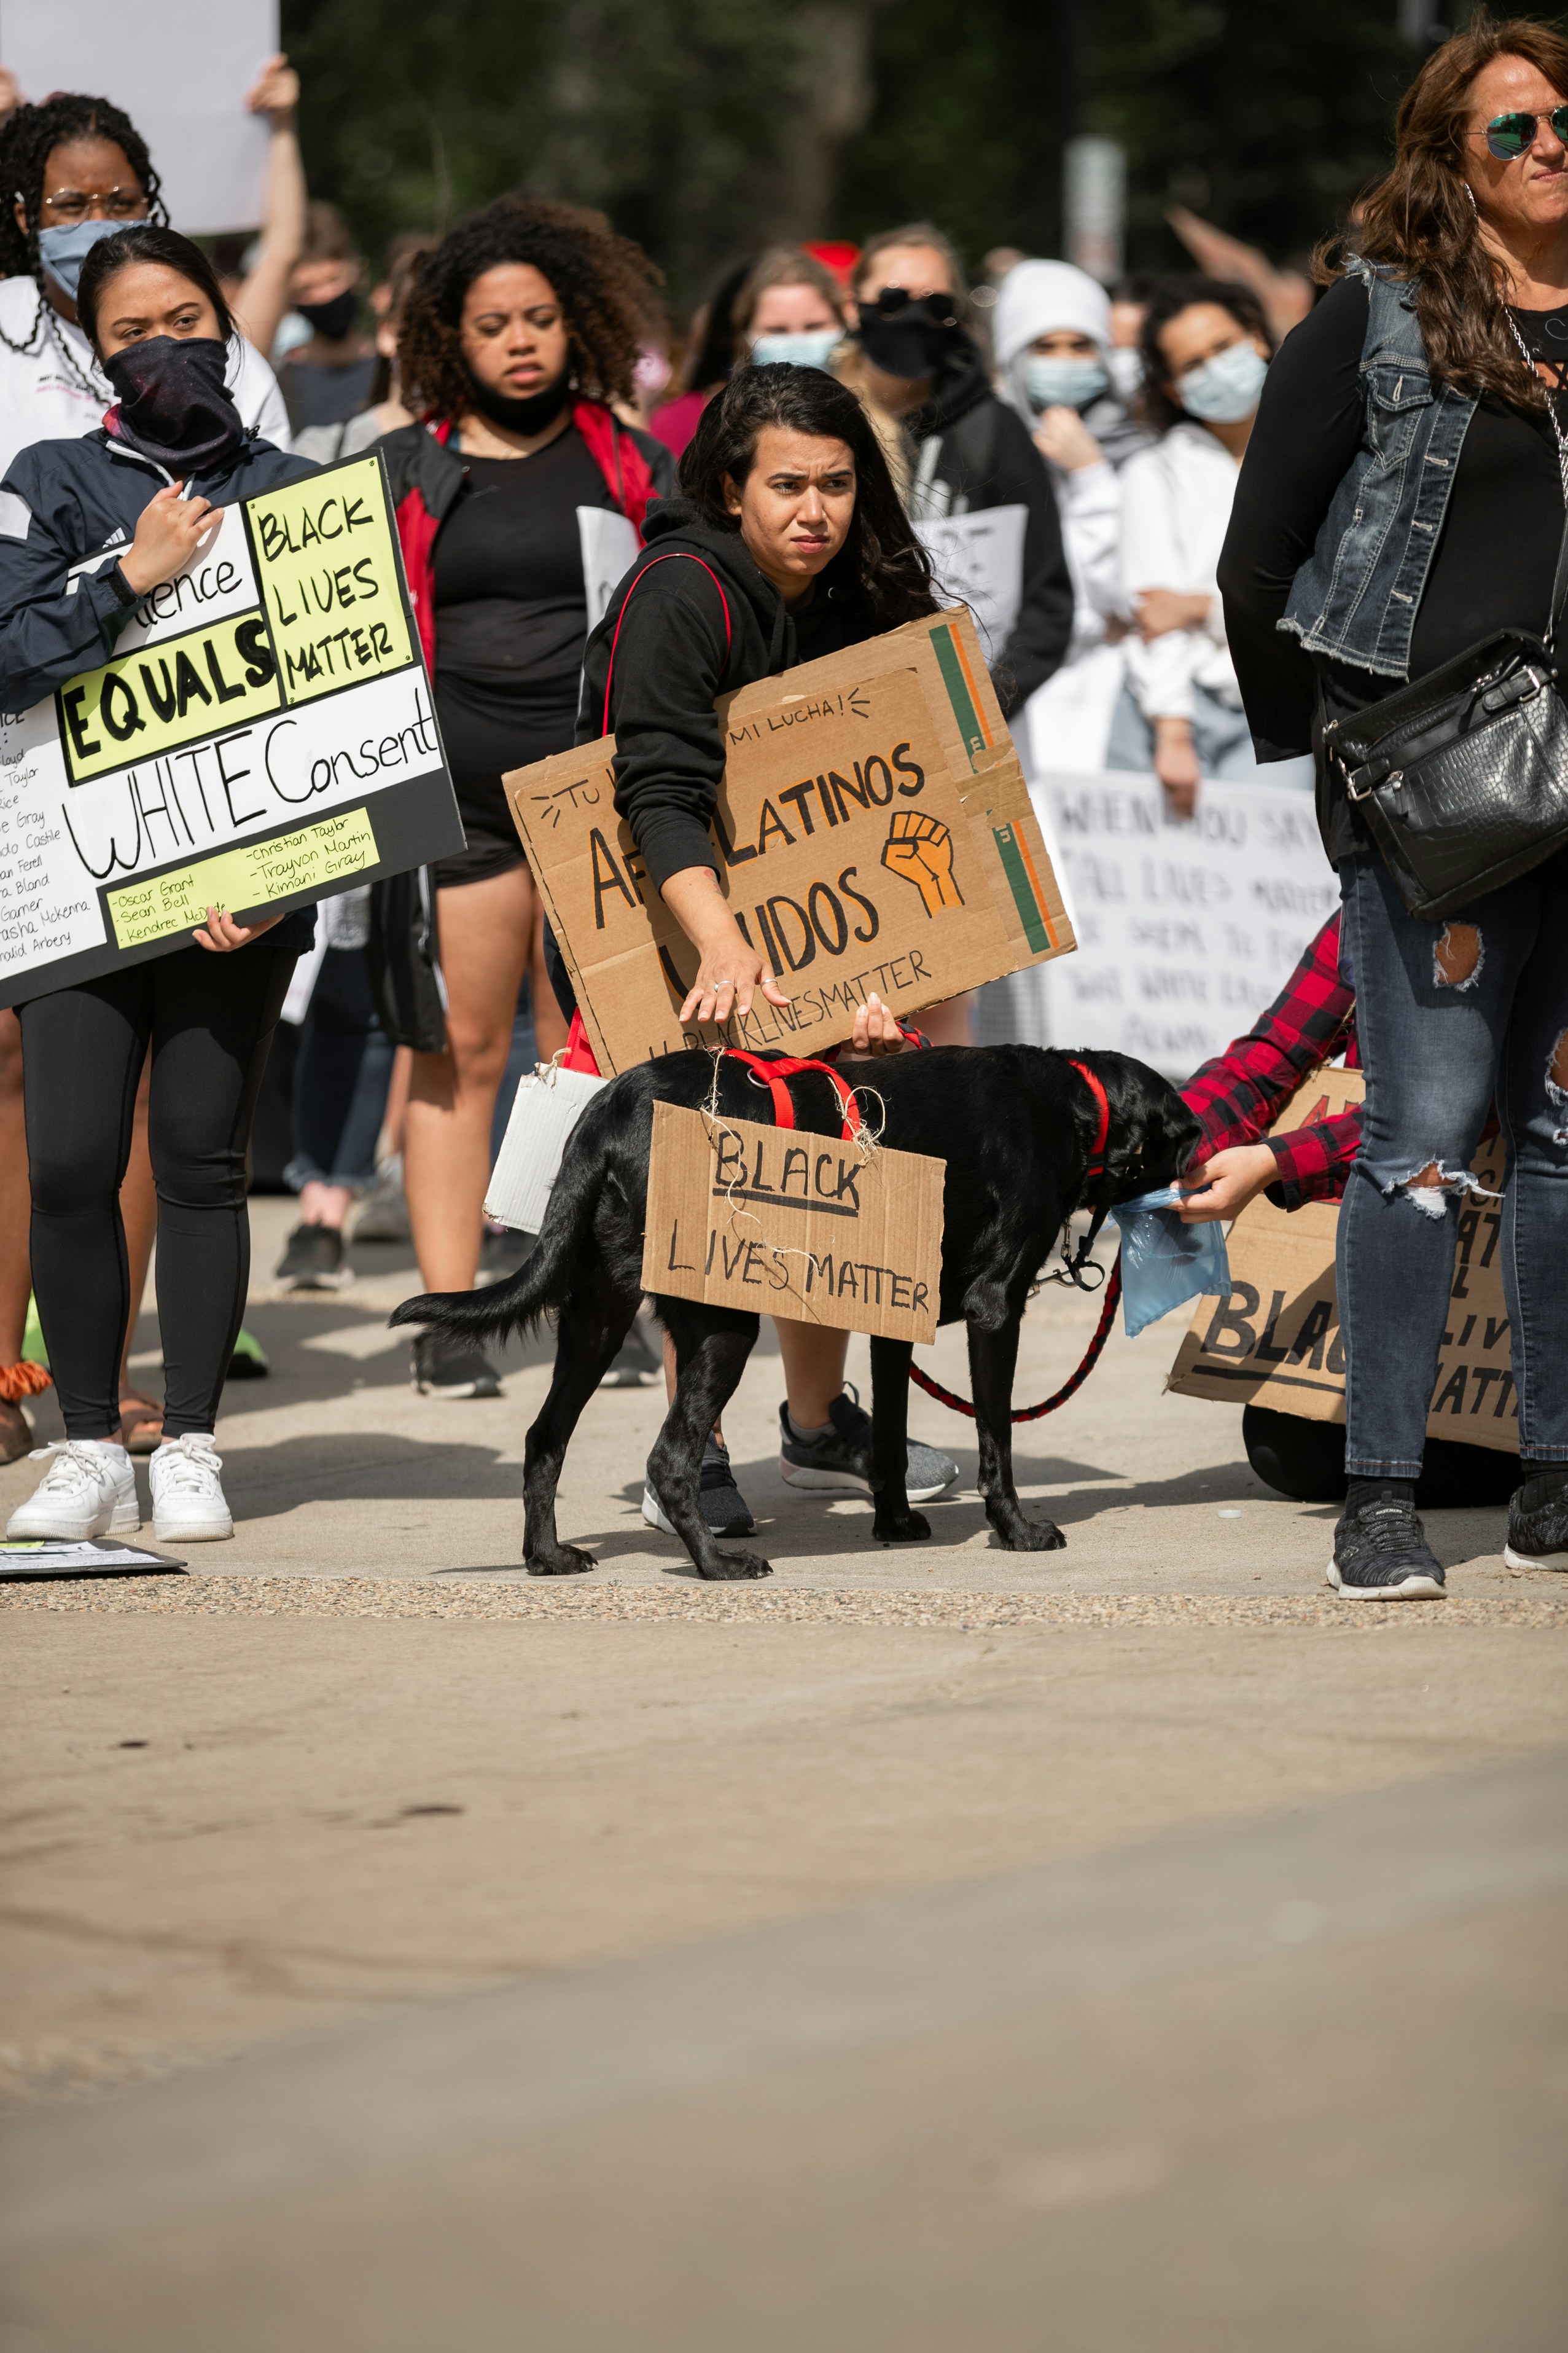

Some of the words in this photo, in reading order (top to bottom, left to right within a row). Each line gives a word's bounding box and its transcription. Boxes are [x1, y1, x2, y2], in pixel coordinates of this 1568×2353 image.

[257, 496, 374, 562] BLACK
[135, 562, 243, 628] ence
[273, 558, 378, 626] LIVES
[284, 622, 393, 689] MATTER
[63, 619, 276, 759] EQUALS
[0, 748, 25, 768] loyd
[552, 779, 600, 808] TU
[729, 724, 760, 745] MI
[767, 695, 844, 731] LUCHA!
[4, 768, 39, 788] Taylor
[61, 730, 267, 879] WHITE
[265, 688, 437, 802] Consent
[17, 811, 45, 829] Gray
[311, 818, 348, 838] Taylor
[26, 829, 60, 849] Castile
[325, 831, 370, 855] Martin
[326, 850, 366, 874] Gray
[16, 874, 49, 895] Bland
[160, 874, 194, 896] Grant
[1, 898, 42, 922] Garner
[163, 897, 189, 912] Bell
[184, 901, 225, 923] McDde
[0, 922, 38, 941] asha
[33, 932, 71, 951] Arbery
[716, 1130, 860, 1211] BLACK
[668, 1219, 789, 1290] LIVES
[805, 1253, 929, 1314] MATTER
